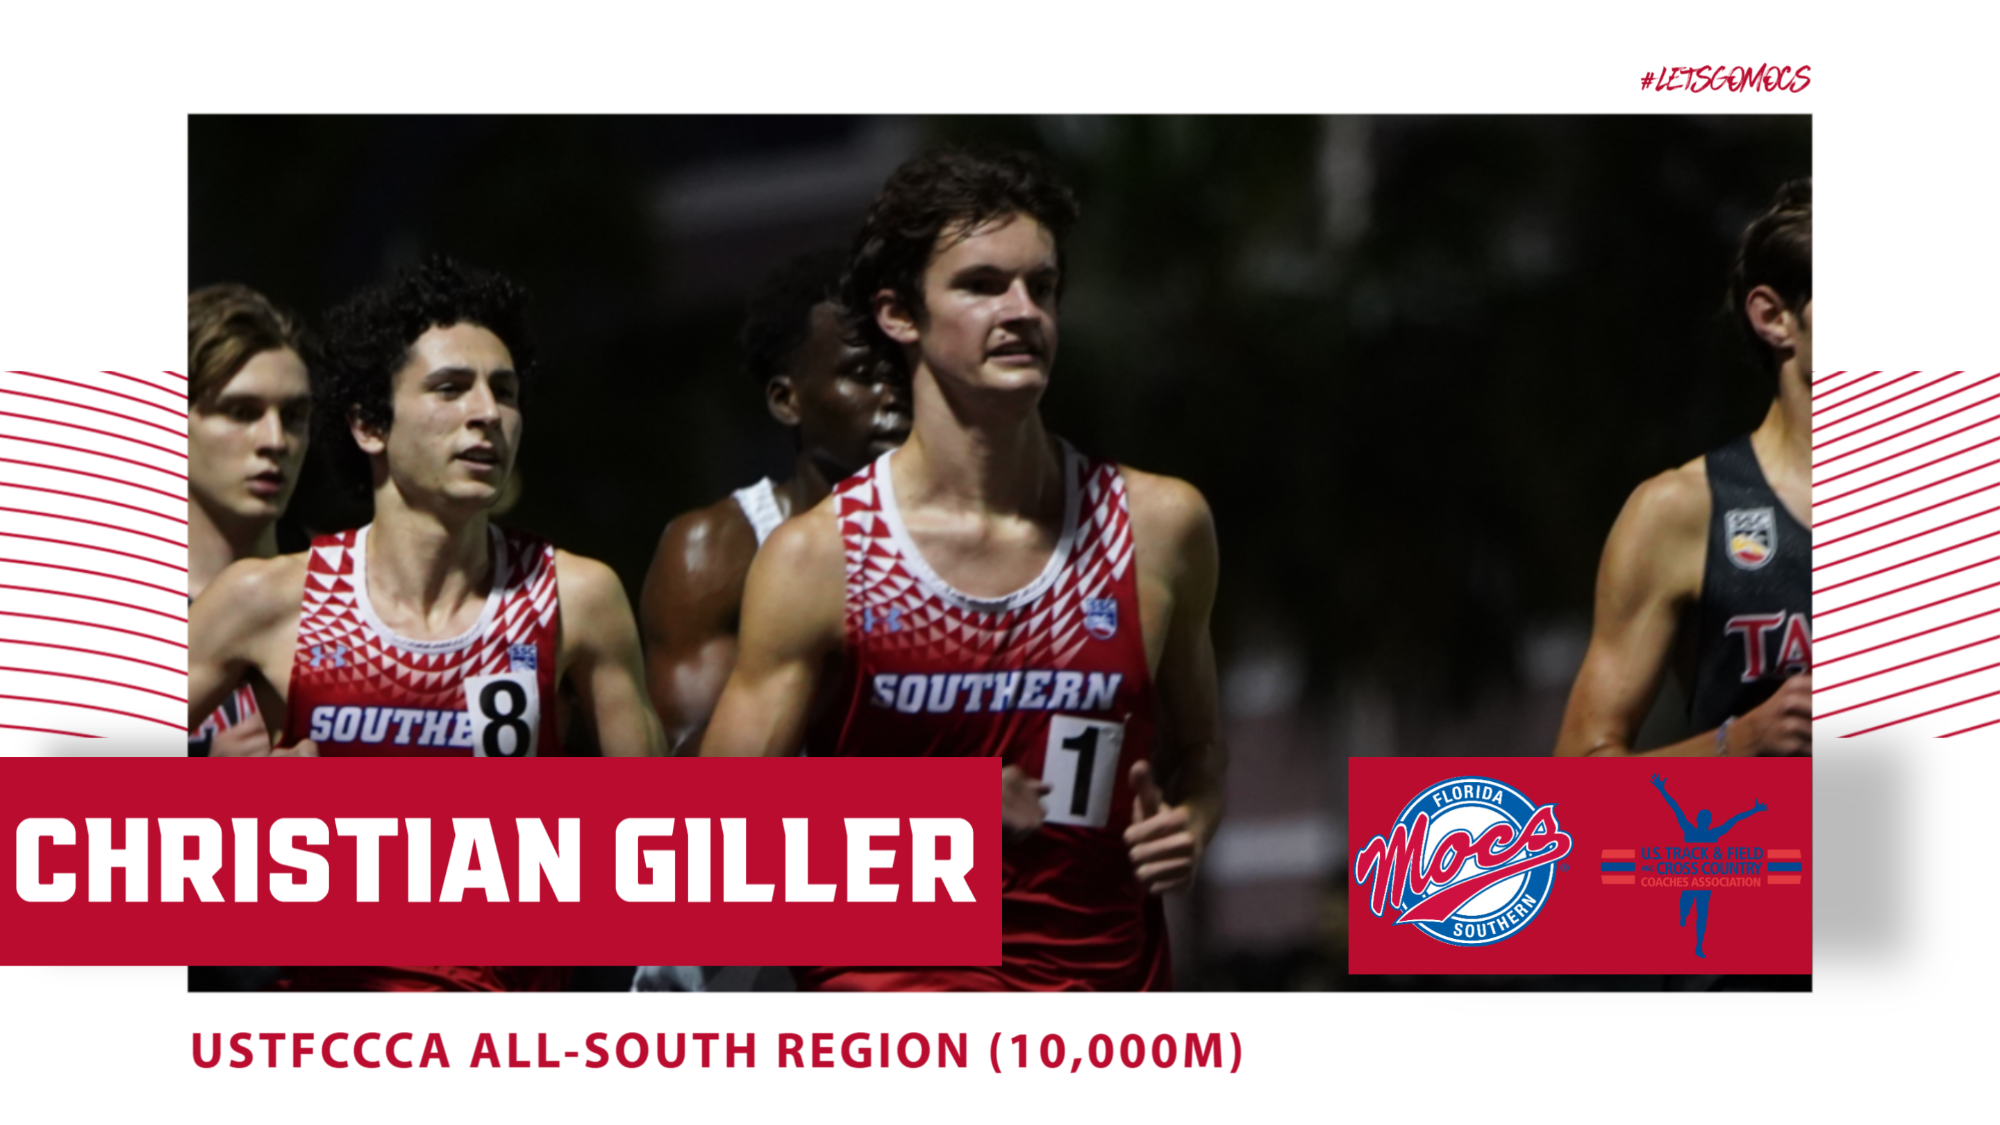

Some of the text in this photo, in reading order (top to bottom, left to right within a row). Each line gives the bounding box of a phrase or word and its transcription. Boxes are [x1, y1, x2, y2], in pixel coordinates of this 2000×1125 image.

[479, 679, 531, 757] 8
[872, 670, 1122, 714] SOUTHERN
[1061, 725, 1100, 817] 1
